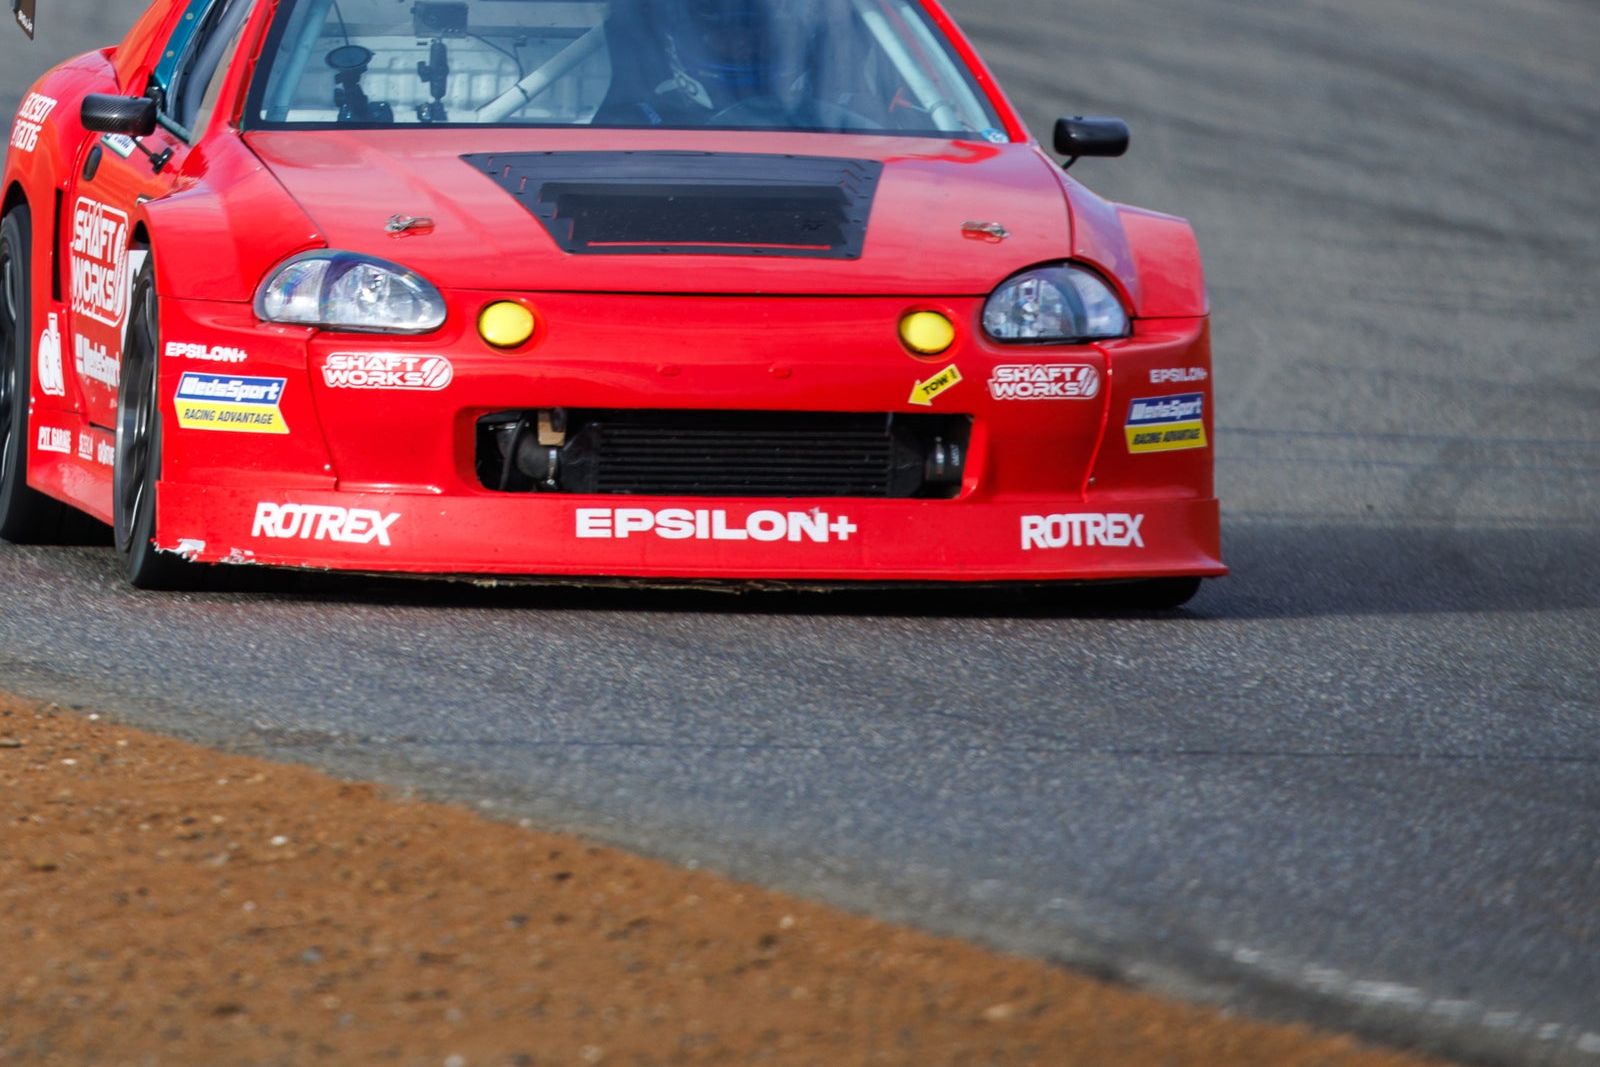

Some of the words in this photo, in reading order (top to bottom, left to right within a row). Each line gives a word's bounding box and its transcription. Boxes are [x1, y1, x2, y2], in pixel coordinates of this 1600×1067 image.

[73, 208, 117, 264] SHAFT
[71, 255, 115, 313] WORKS
[165, 341, 248, 363] EPSILON+
[329, 355, 421, 372] SHAFT
[995, 366, 1076, 383] SHAFT
[325, 368, 425, 387] WORKS
[921, 374, 949, 396] TOW
[179, 377, 281, 402] WedsSport
[993, 381, 1081, 397] WORKS
[183, 407, 217, 422] RACING
[217, 410, 275, 426] ADVANTAGE
[250, 502, 401, 547] ROTREX
[575, 507, 858, 542] EPSILON+
[1020, 512, 1146, 550] ROTREX
